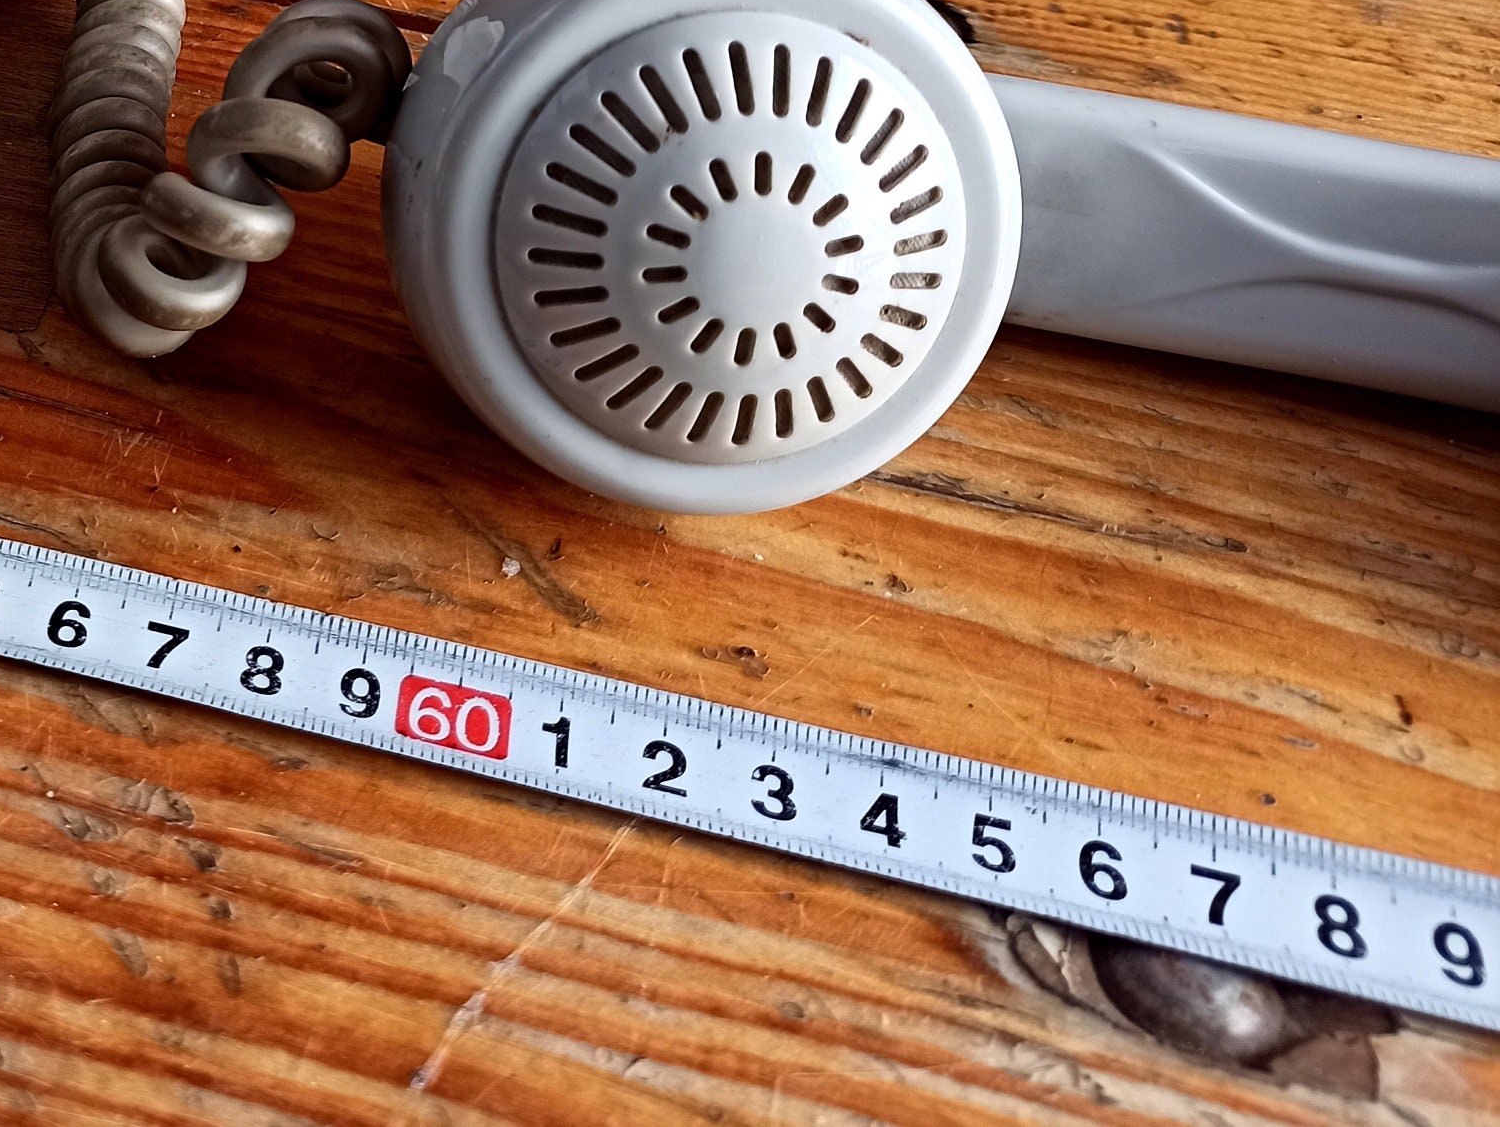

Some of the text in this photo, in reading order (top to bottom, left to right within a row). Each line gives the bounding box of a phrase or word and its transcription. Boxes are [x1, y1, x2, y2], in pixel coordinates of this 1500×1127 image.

[47, 601, 92, 648] 6
[147, 620, 190, 670] 7
[240, 645, 285, 695] 8
[339, 667, 381, 719] 9
[408, 687, 501, 753] 60
[541, 716, 571, 769] 1
[642, 739, 688, 798] 2
[750, 764, 797, 822] 3
[859, 792, 907, 849] 4
[971, 813, 1017, 874] 5
[1078, 840, 1128, 902] 6
[1189, 863, 1241, 926] 7
[1313, 894, 1369, 960] 8
[1432, 921, 1486, 989] 9
